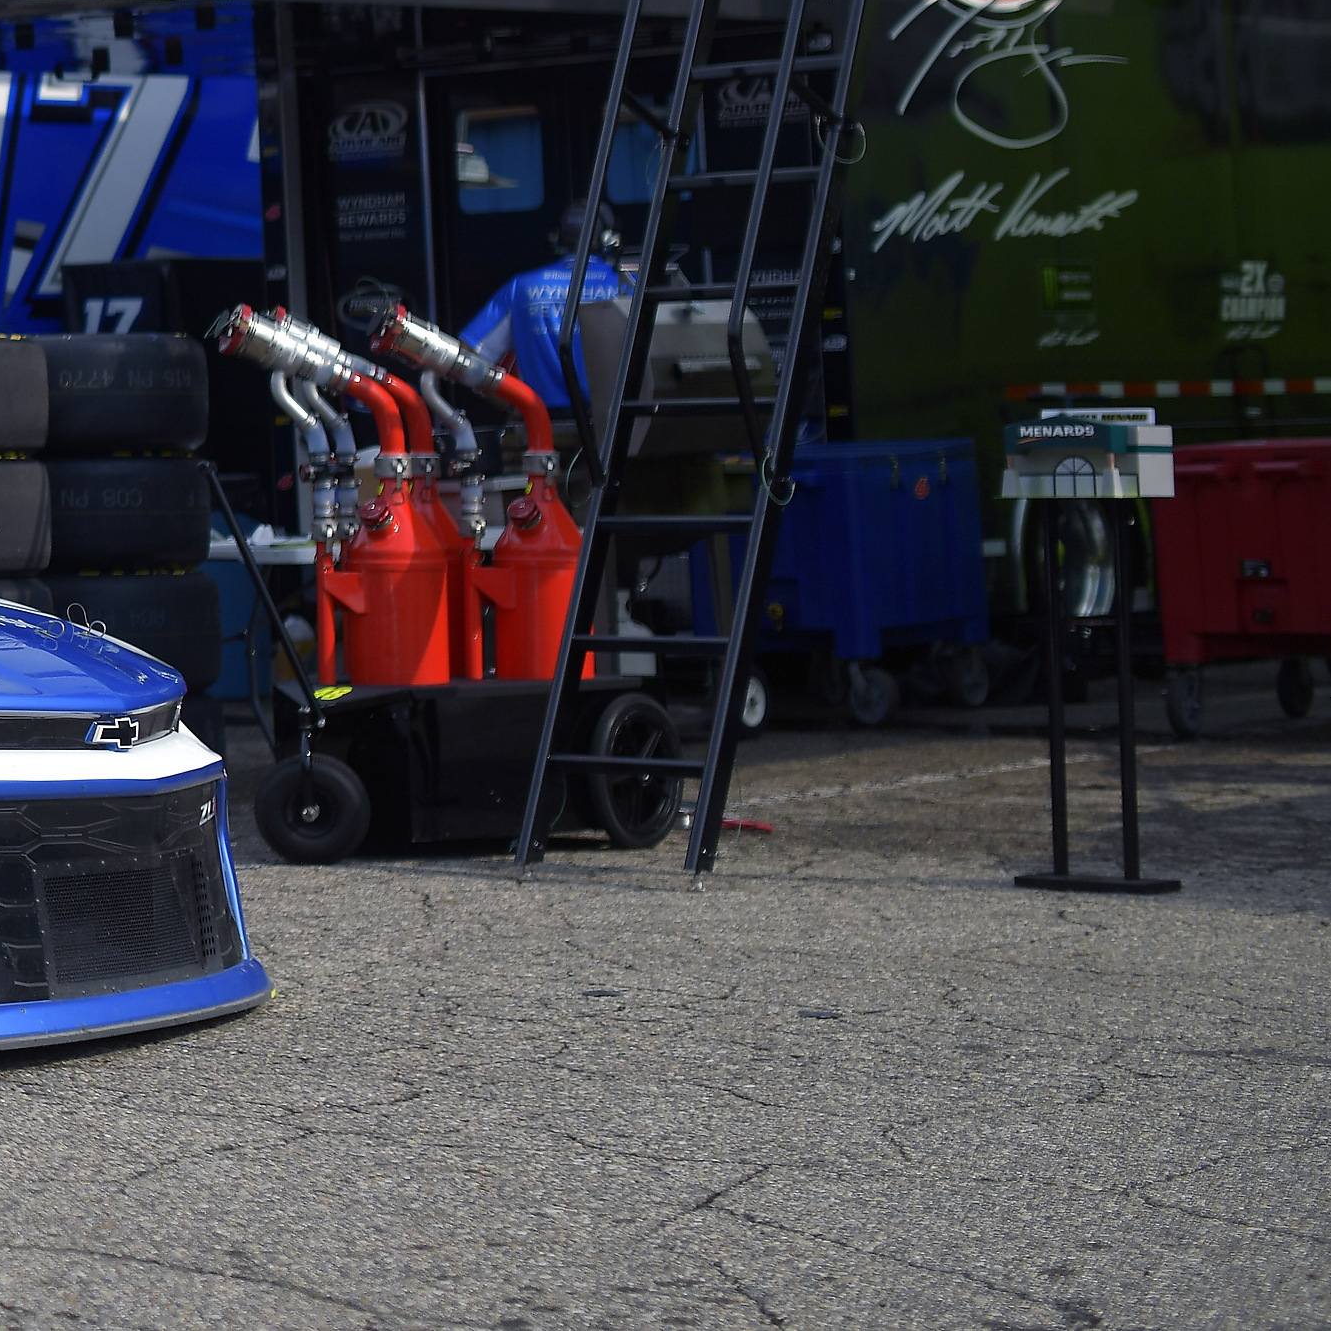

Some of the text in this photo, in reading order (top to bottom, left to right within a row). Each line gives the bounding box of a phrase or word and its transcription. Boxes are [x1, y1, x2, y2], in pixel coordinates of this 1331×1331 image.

[337, 191, 406, 210] WYNDHAM
[82, 297, 144, 335] 17
[58, 369, 115, 389] 4770
[1019, 424, 1096, 438] MENARDS
[60, 488, 89, 507] PN
[198, 796, 217, 826] ZL1
